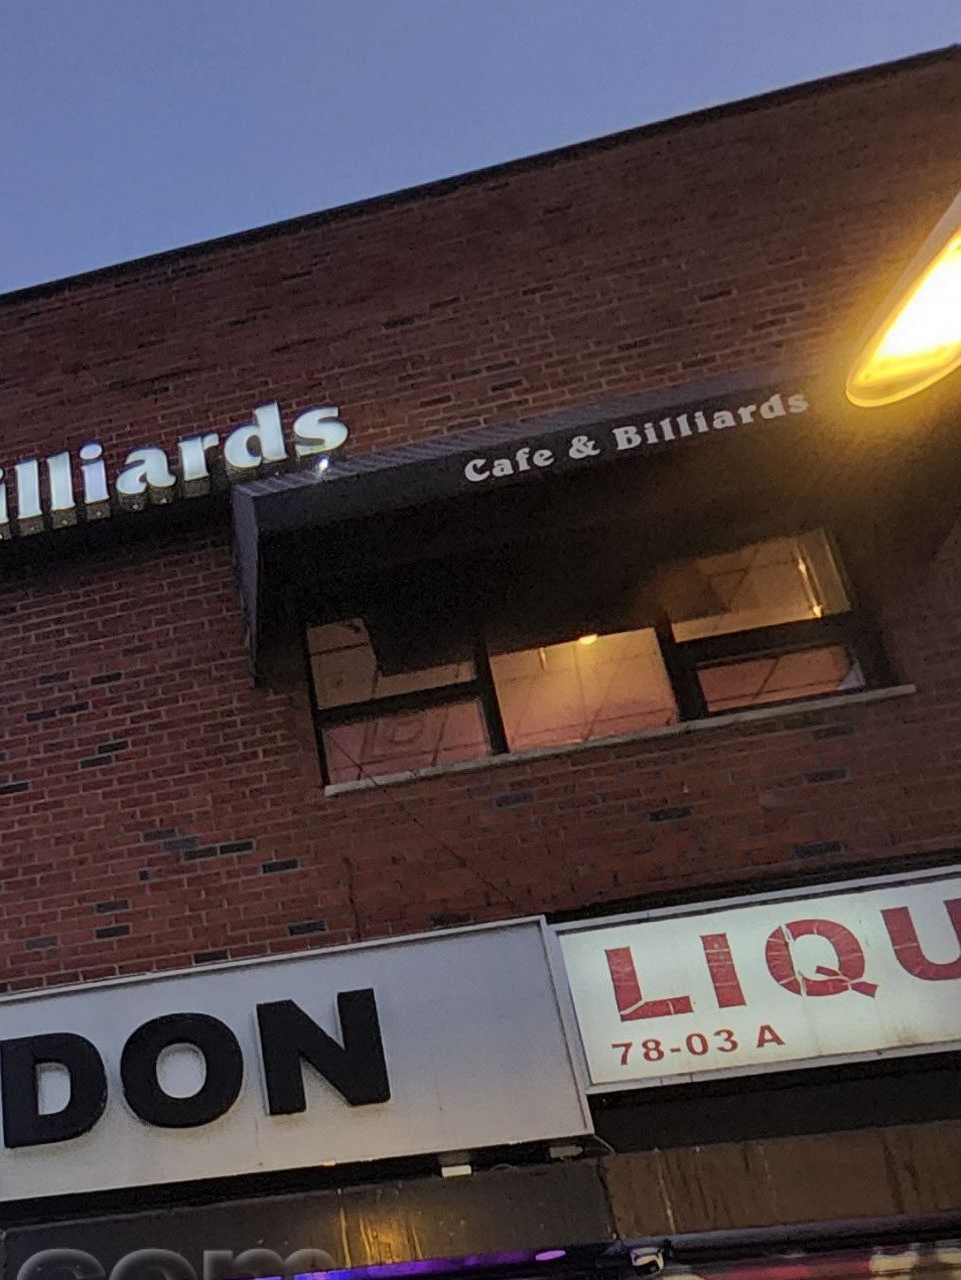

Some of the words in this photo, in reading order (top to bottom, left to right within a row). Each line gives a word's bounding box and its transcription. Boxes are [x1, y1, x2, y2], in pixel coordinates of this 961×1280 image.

[463, 446, 554, 484] Cafe
[568, 435, 601, 460] &
[612, 391, 810, 452] Billiards
[612, 1028, 738, 1066] 78-03
[756, 1024, 786, 1048] A
